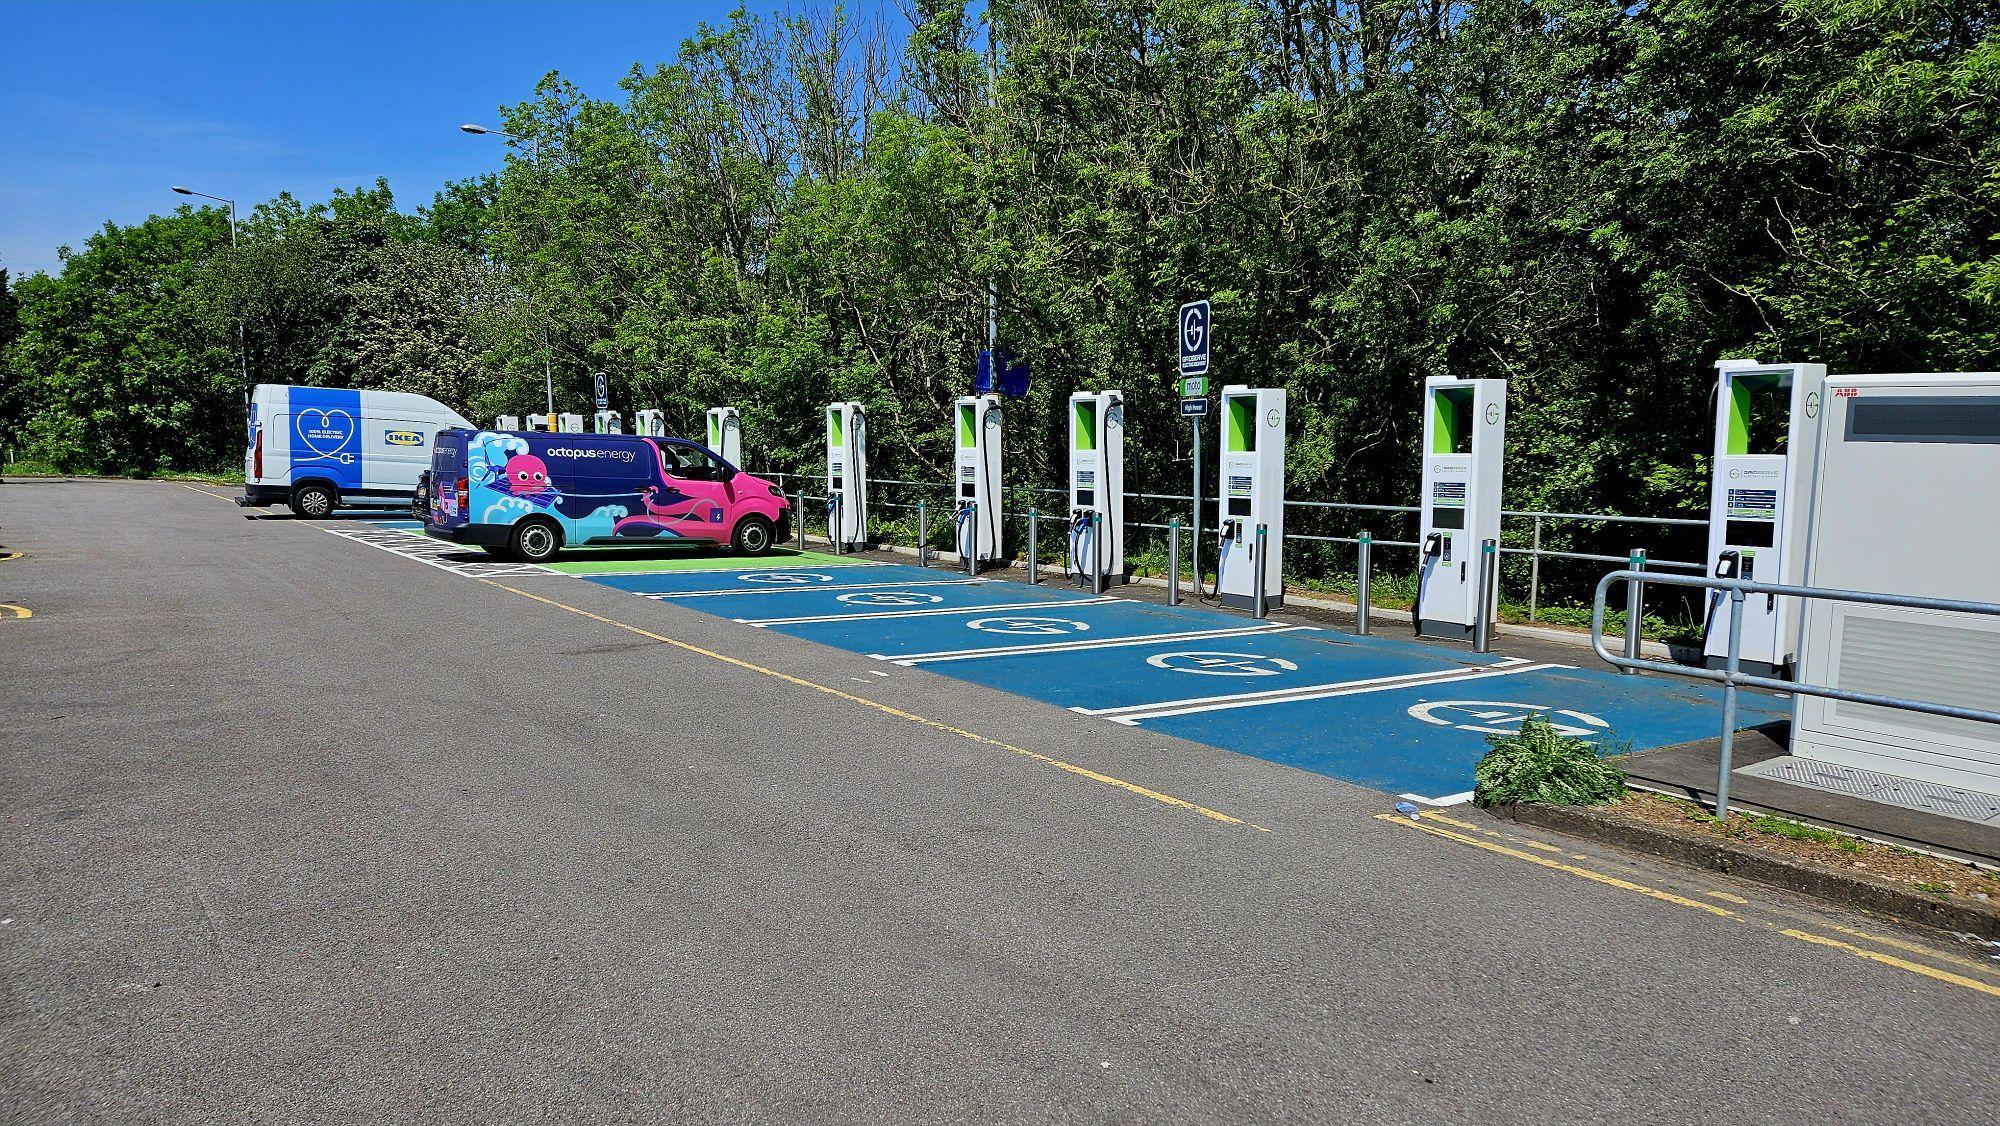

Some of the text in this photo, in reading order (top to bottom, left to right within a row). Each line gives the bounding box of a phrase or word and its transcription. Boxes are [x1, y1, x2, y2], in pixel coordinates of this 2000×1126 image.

[1835, 388, 1858, 397] ABB
[388, 434, 420, 442] IKEA
[547, 447, 636, 462] octopus energy
